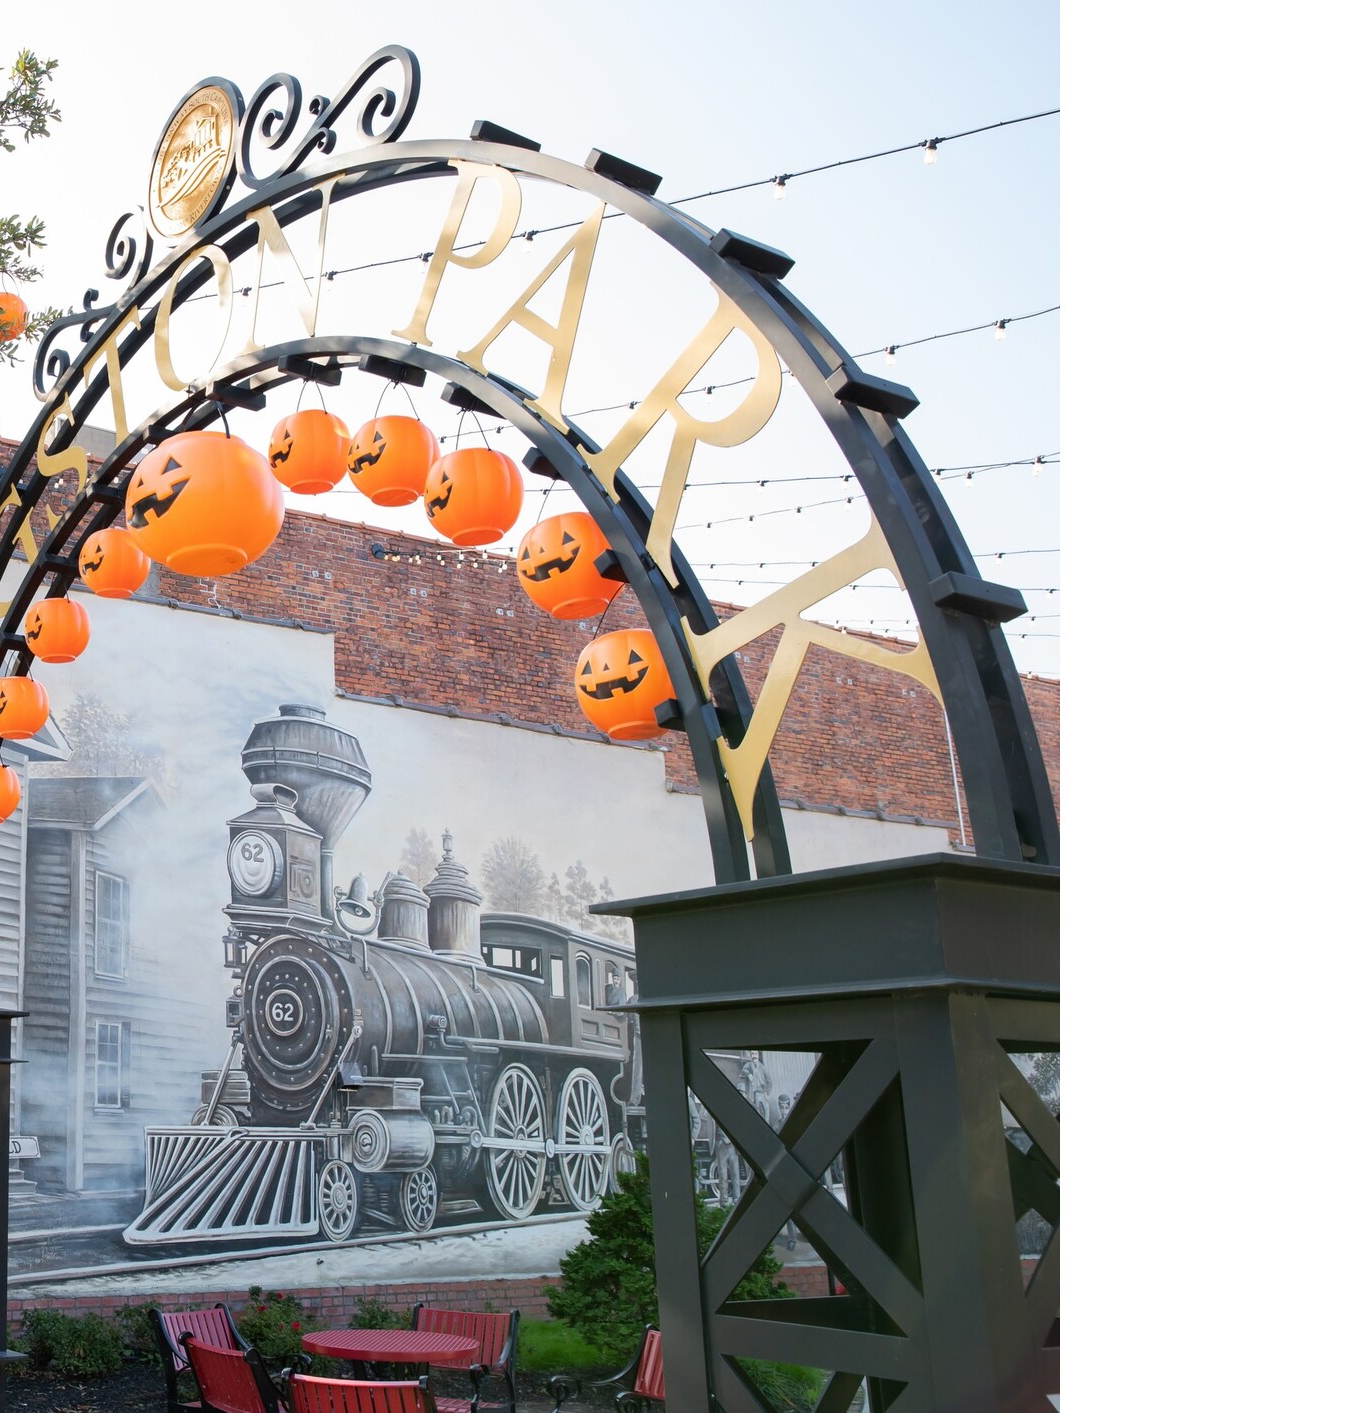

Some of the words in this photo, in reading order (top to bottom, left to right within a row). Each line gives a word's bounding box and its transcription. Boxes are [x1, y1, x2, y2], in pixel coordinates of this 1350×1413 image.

[391, 159, 948, 843] PARK
[241, 842, 264, 863] 62
[271, 1002, 294, 1022] 62
